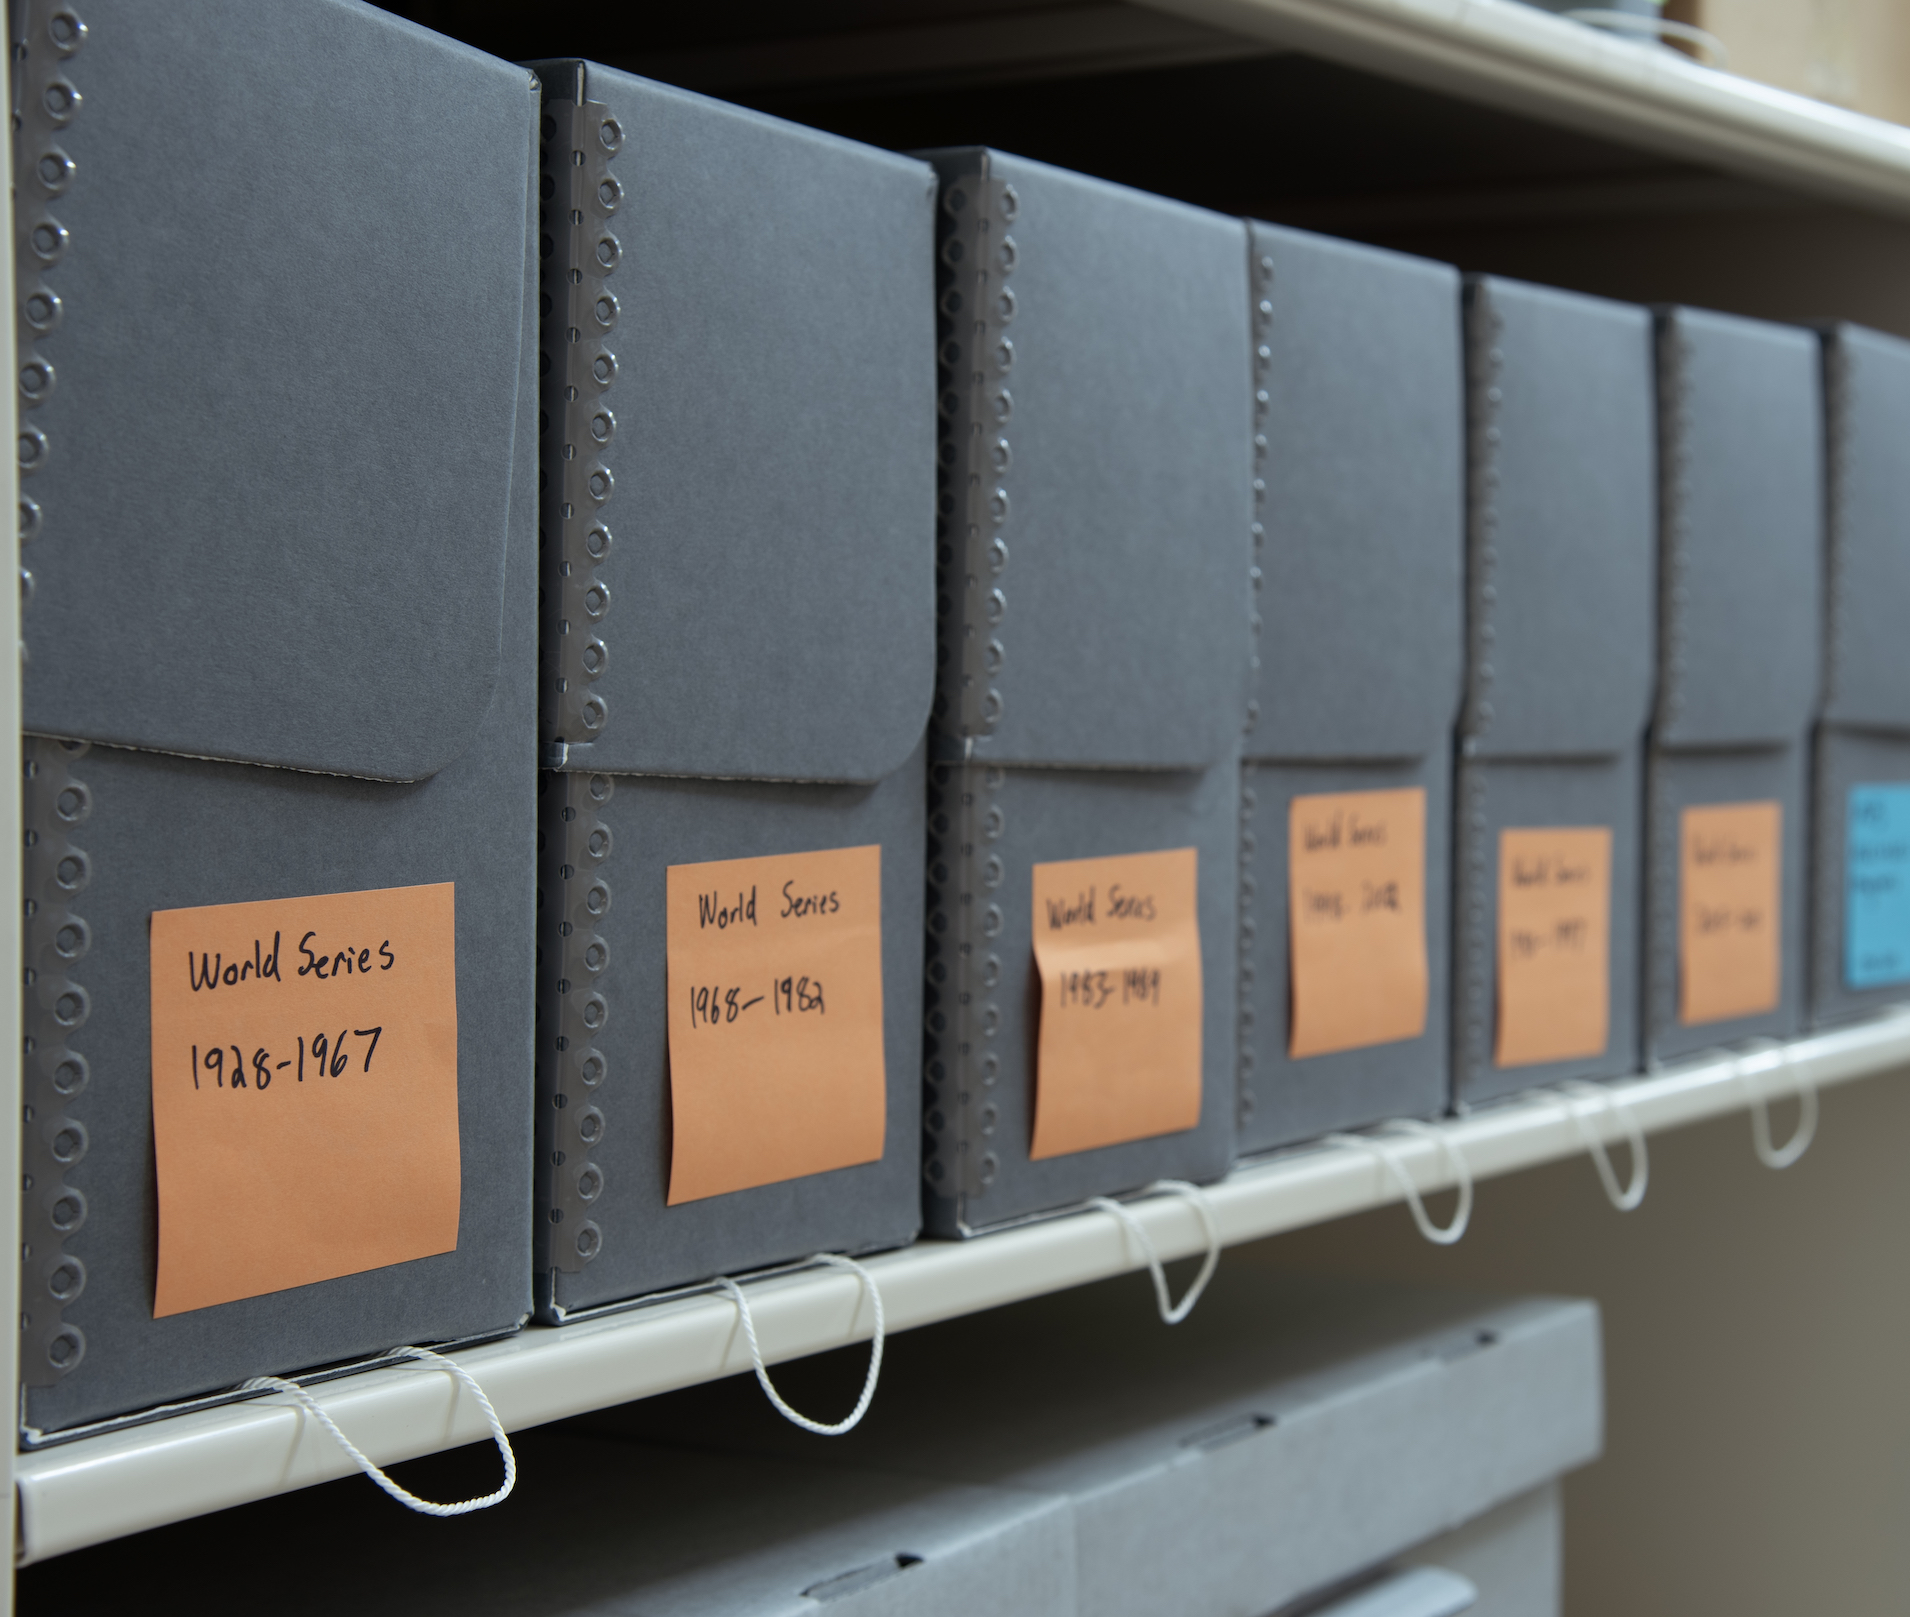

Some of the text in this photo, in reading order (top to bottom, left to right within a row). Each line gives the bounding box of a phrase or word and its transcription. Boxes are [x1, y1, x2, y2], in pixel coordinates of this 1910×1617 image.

[699, 879, 840, 930] World Series
[1046, 884, 1097, 931] World
[188, 930, 395, 992] World Series
[191, 1026, 383, 1091] 1928-1967
